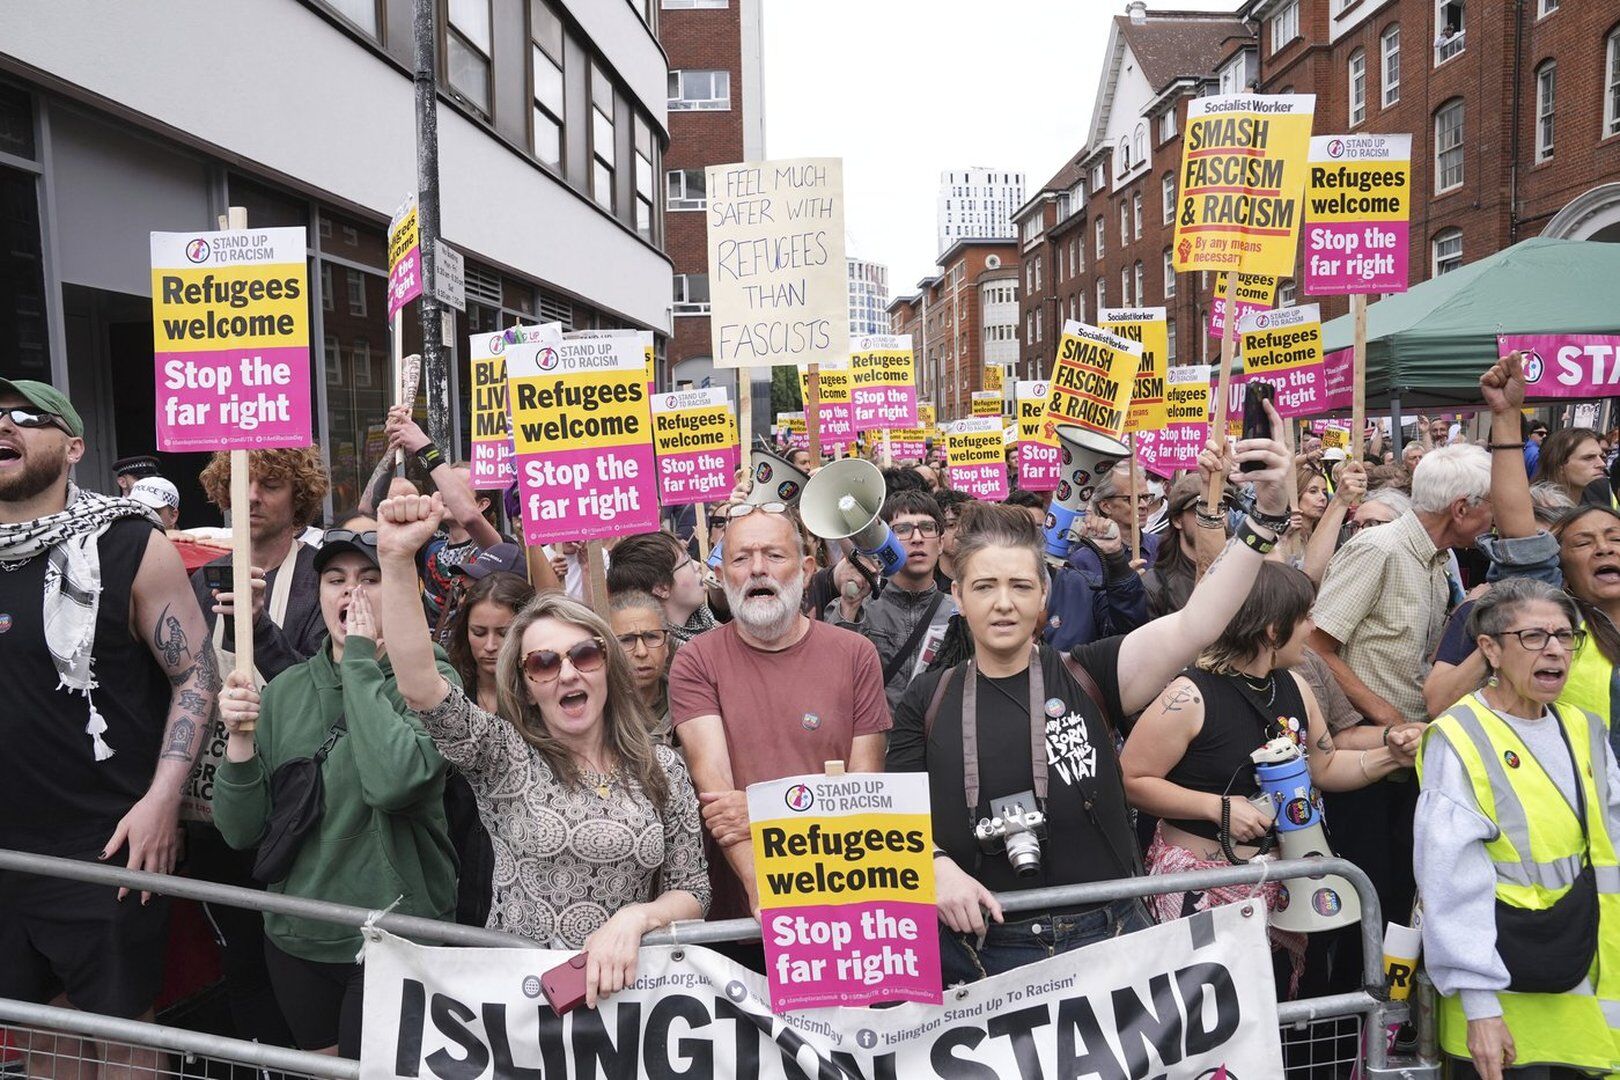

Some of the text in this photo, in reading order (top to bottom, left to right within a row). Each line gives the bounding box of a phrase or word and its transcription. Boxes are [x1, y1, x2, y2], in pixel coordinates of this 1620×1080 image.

[1189, 118, 1269, 150] SMASH
[1346, 139, 1385, 148] STAND UP
[1346, 148, 1388, 157] TO RACISM
[711, 165, 825, 197] I FEEL MUCH
[1185, 156, 1284, 189] FASCISM
[1311, 167, 1405, 191] Refugees
[712, 198, 832, 227] SAFER WITH
[1181, 195, 1295, 228] & RACISM
[1312, 194, 1399, 214] welcome
[213, 236, 267, 250] STAND UP
[1195, 236, 1262, 253] By any means
[1310, 227, 1397, 253] Stop the
[214, 248, 274, 262] TO RACISM
[718, 231, 828, 281] REFUGEES
[1194, 252, 1241, 266] necessary
[398, 257, 414, 277] the
[1310, 254, 1394, 280] far right
[162, 275, 300, 308] Refugees
[742, 279, 805, 309] THAN
[1218, 285, 1268, 300] wcome
[163, 311, 294, 339] welcome
[1270, 312, 1290, 321] STAND
[1282, 315, 1304, 325] RACISM
[720, 319, 830, 359] FASCISTS
[1246, 328, 1318, 351] Refugees
[560, 344, 612, 357] STAND UP
[1062, 339, 1114, 372] SMASH
[1248, 347, 1316, 368] welcome
[564, 354, 618, 369] TO RACISM
[852, 353, 911, 369] Refugees
[165, 357, 291, 395] Stop the
[476, 360, 507, 386] BLA
[803, 375, 847, 387] Rugees
[854, 368, 908, 383] welcome
[1290, 371, 1315, 387] the
[1055, 365, 1119, 402] FASCISM
[1131, 378, 1163, 399] CISM
[476, 386, 506, 411] LIV
[517, 381, 642, 411] Refugees
[687, 398, 711, 406] RACISM
[805, 388, 847, 399] lcome
[855, 389, 908, 406] Stop the
[1167, 388, 1206, 403] efugees
[1279, 387, 1316, 407] right
[165, 393, 290, 429] far right
[834, 406, 848, 417] the
[855, 406, 874, 420] far
[877, 404, 908, 421] right
[1049, 392, 1062, 413] &
[1066, 400, 1122, 431] RACISM
[1167, 405, 1203, 418] elcome
[521, 414, 639, 442] welcome
[657, 414, 726, 431] Refugees
[828, 421, 850, 435] right
[660, 432, 724, 449] welcome
[949, 436, 1001, 449] Refugees
[1160, 426, 1200, 441] Stop the
[476, 445, 494, 459] No
[950, 450, 1000, 461] welcome
[1023, 445, 1057, 463] Stop
[1140, 445, 1156, 462] rig
[1159, 442, 1200, 460] far right
[476, 461, 494, 475] No
[525, 459, 589, 490] Stop
[596, 453, 639, 480] the
[662, 455, 725, 475] Stop the
[951, 466, 999, 481] Stop the
[1023, 463, 1045, 478] far
[664, 473, 726, 492] far right
[972, 480, 1000, 494] right
[528, 486, 640, 521] far right
[817, 781, 884, 796] STAND UP
[817, 795, 892, 811] TO RACISM
[762, 824, 924, 861] Refugees
[767, 863, 919, 895] welcome
[772, 909, 918, 950] Stop the
[776, 946, 919, 985] far right
[944, 1006, 983, 1024] Stand
[985, 997, 1003, 1013] Up
[1006, 990, 1023, 1004] To
[929, 961, 1241, 1080] STAND
